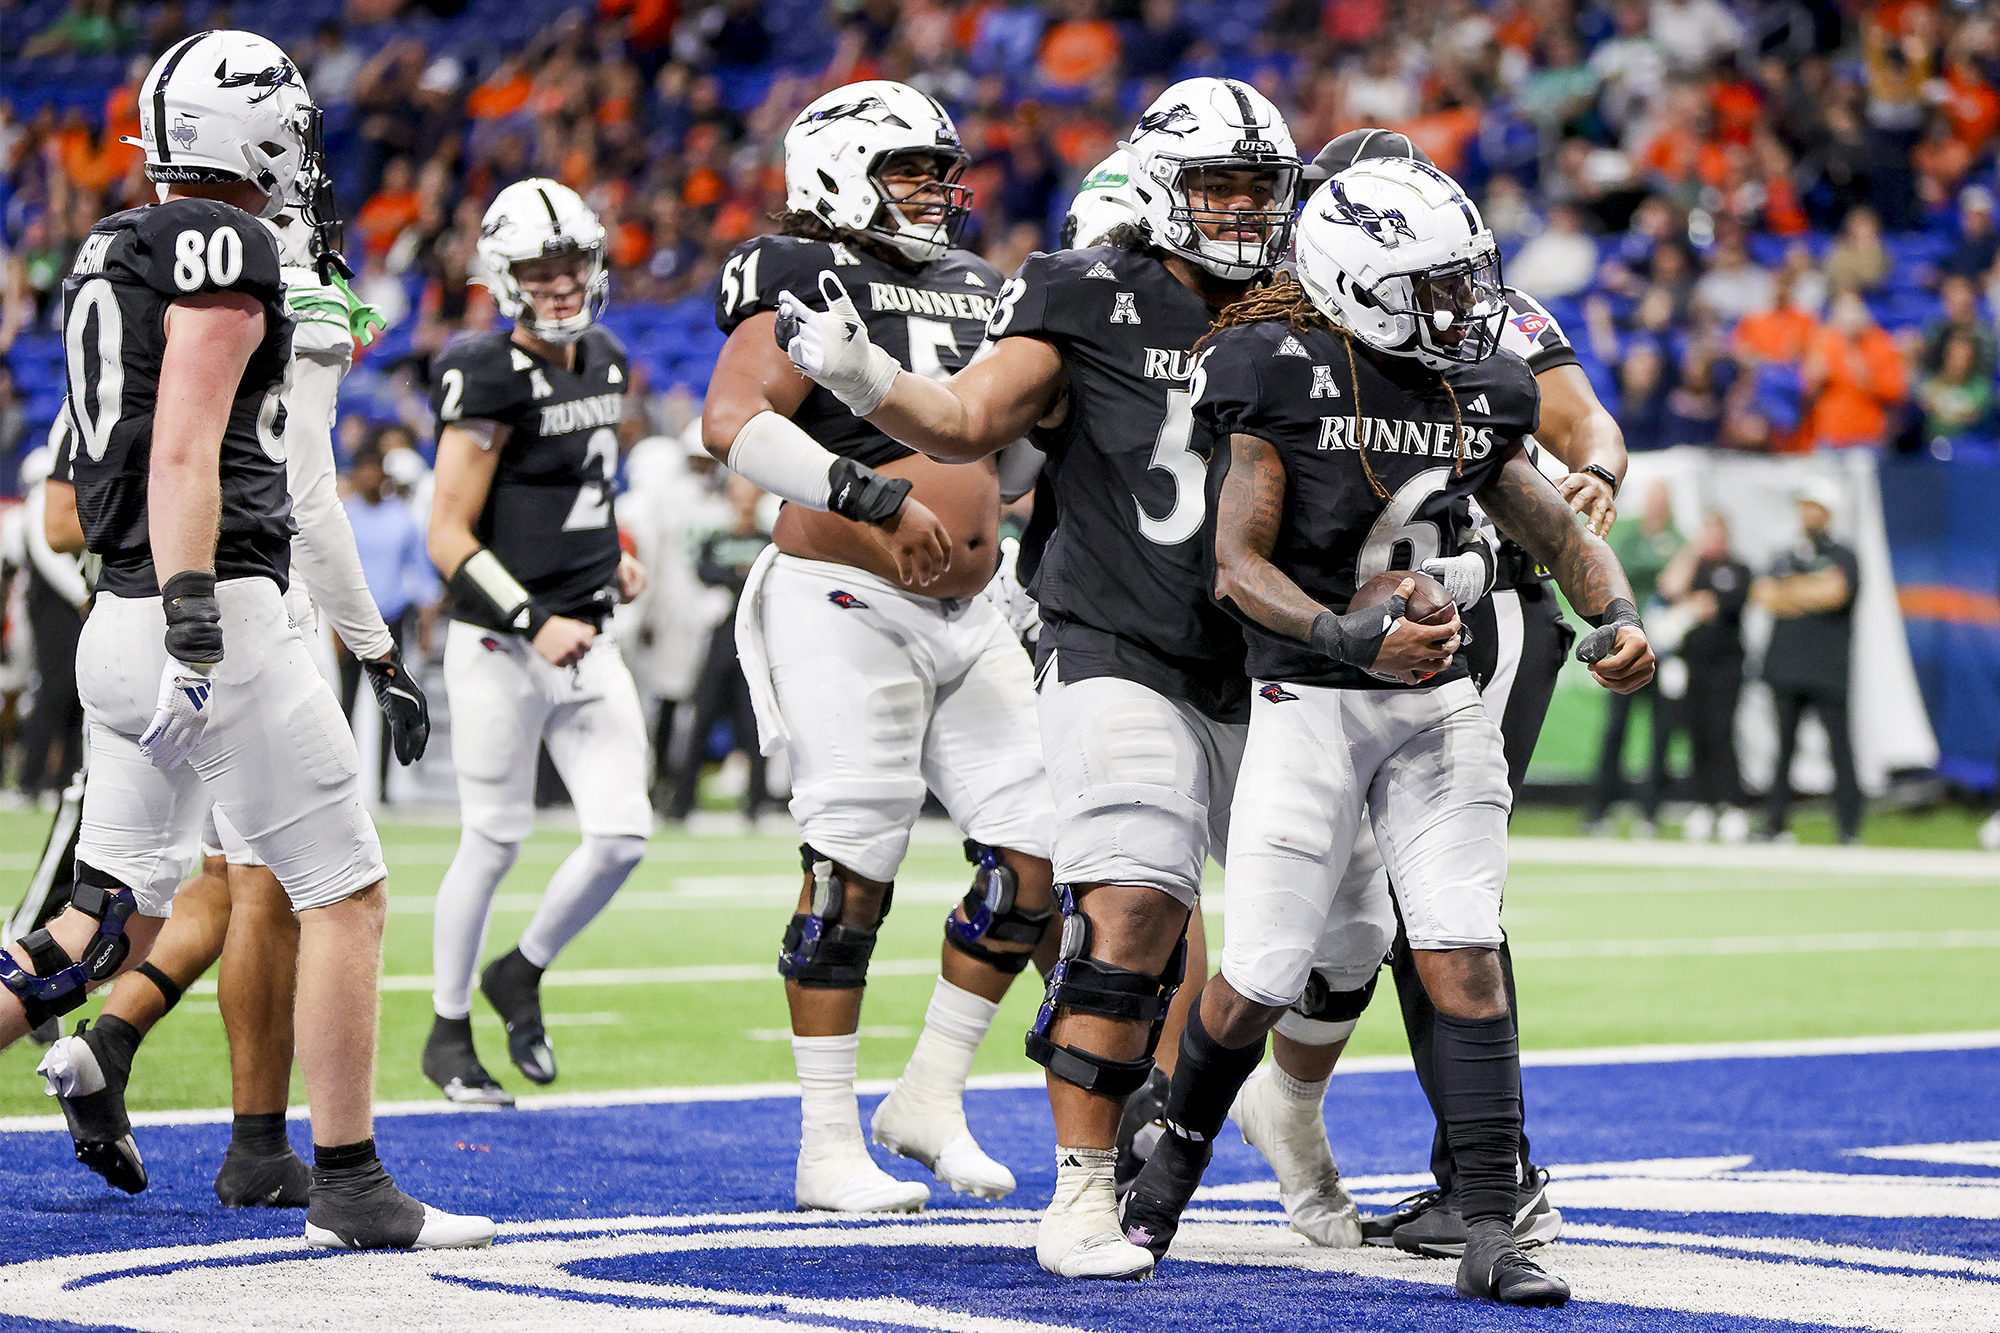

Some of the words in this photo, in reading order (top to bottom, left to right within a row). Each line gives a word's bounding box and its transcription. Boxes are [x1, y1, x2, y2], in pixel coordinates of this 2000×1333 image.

[1240, 141, 1273, 152] UTSA
[174, 226, 243, 292] 80
[721, 248, 761, 317] 51
[1110, 292, 1142, 325] A
[440, 368, 464, 421] 2
[1310, 365, 1341, 399] A
[1317, 416, 1494, 460] RUNNERS
[561, 426, 620, 532] 2
